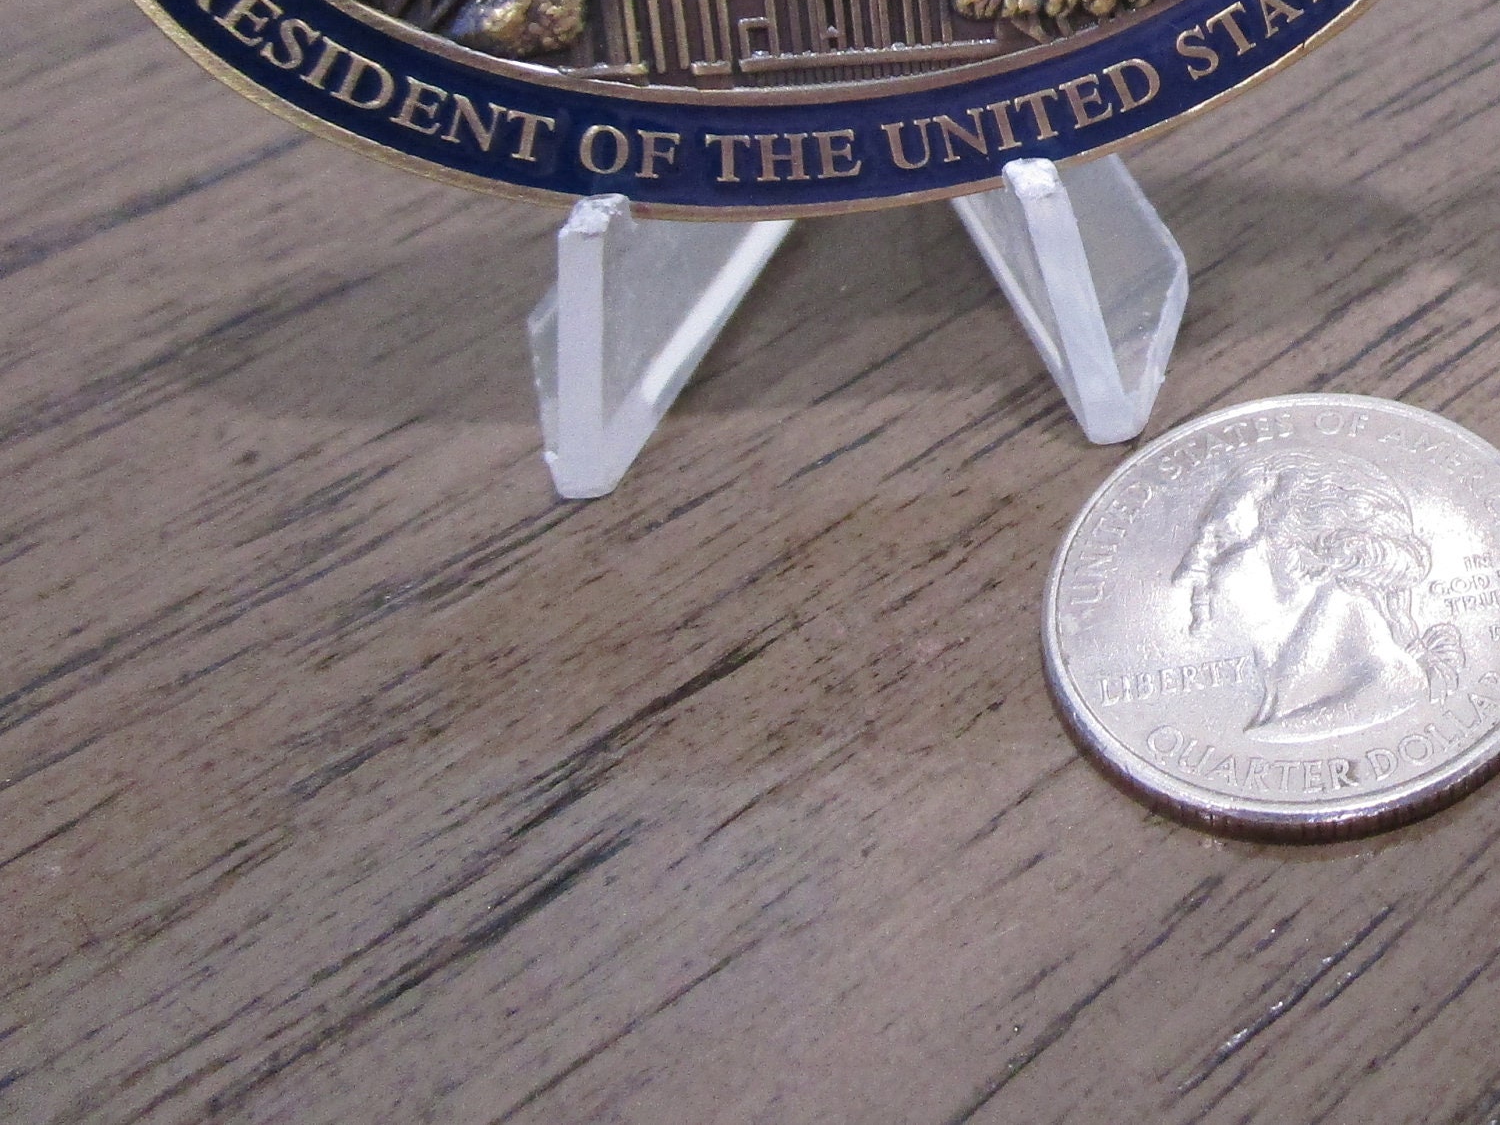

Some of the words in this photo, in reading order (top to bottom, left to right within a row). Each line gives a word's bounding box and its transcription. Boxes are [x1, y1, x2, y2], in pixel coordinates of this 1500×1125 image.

[579, 124, 681, 179] OF
[704, 127, 862, 183] THE
[880, 56, 1162, 171] UNITED
[1157, 412, 1294, 480] STATES
[1315, 410, 1369, 438] OF
[1429, 573, 1491, 596] GOD
[1098, 655, 1249, 707] LIBERTY
[1147, 725, 1359, 794] QUARTER
